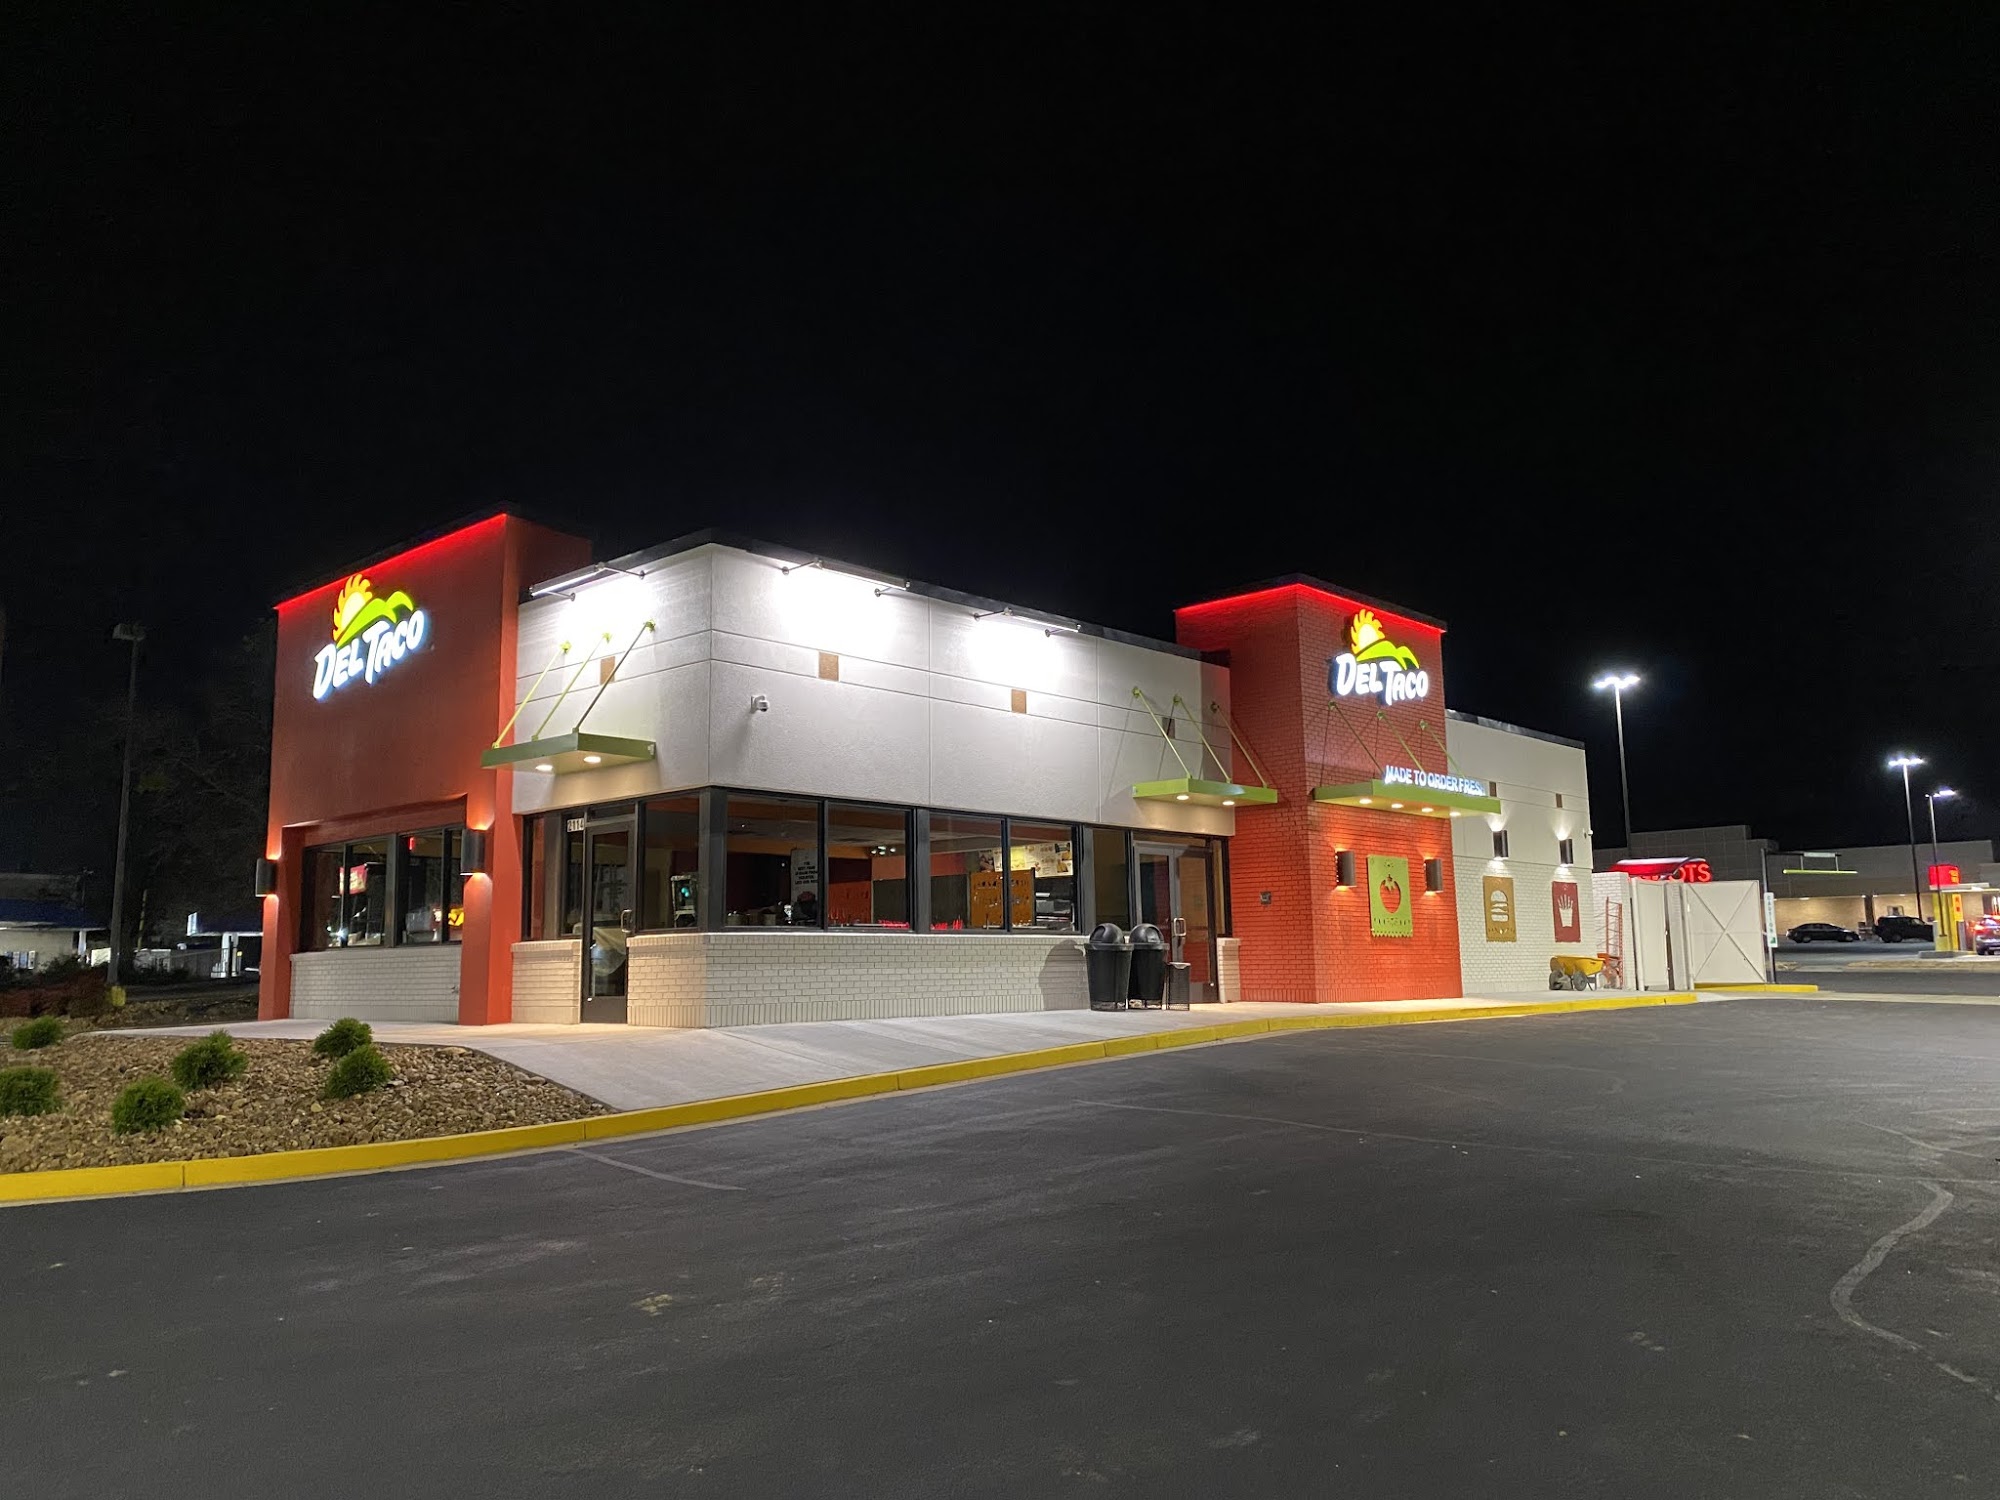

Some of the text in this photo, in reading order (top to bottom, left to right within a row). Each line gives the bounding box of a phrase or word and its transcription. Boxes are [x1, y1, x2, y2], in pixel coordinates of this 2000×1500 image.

[313, 609, 426, 700] DEL TACO
[1336, 653, 1429, 706] DEL TACO
[1384, 765, 1413, 784] MADE
[1413, 769, 1427, 787] TO
[1427, 772, 1459, 792] ORDER
